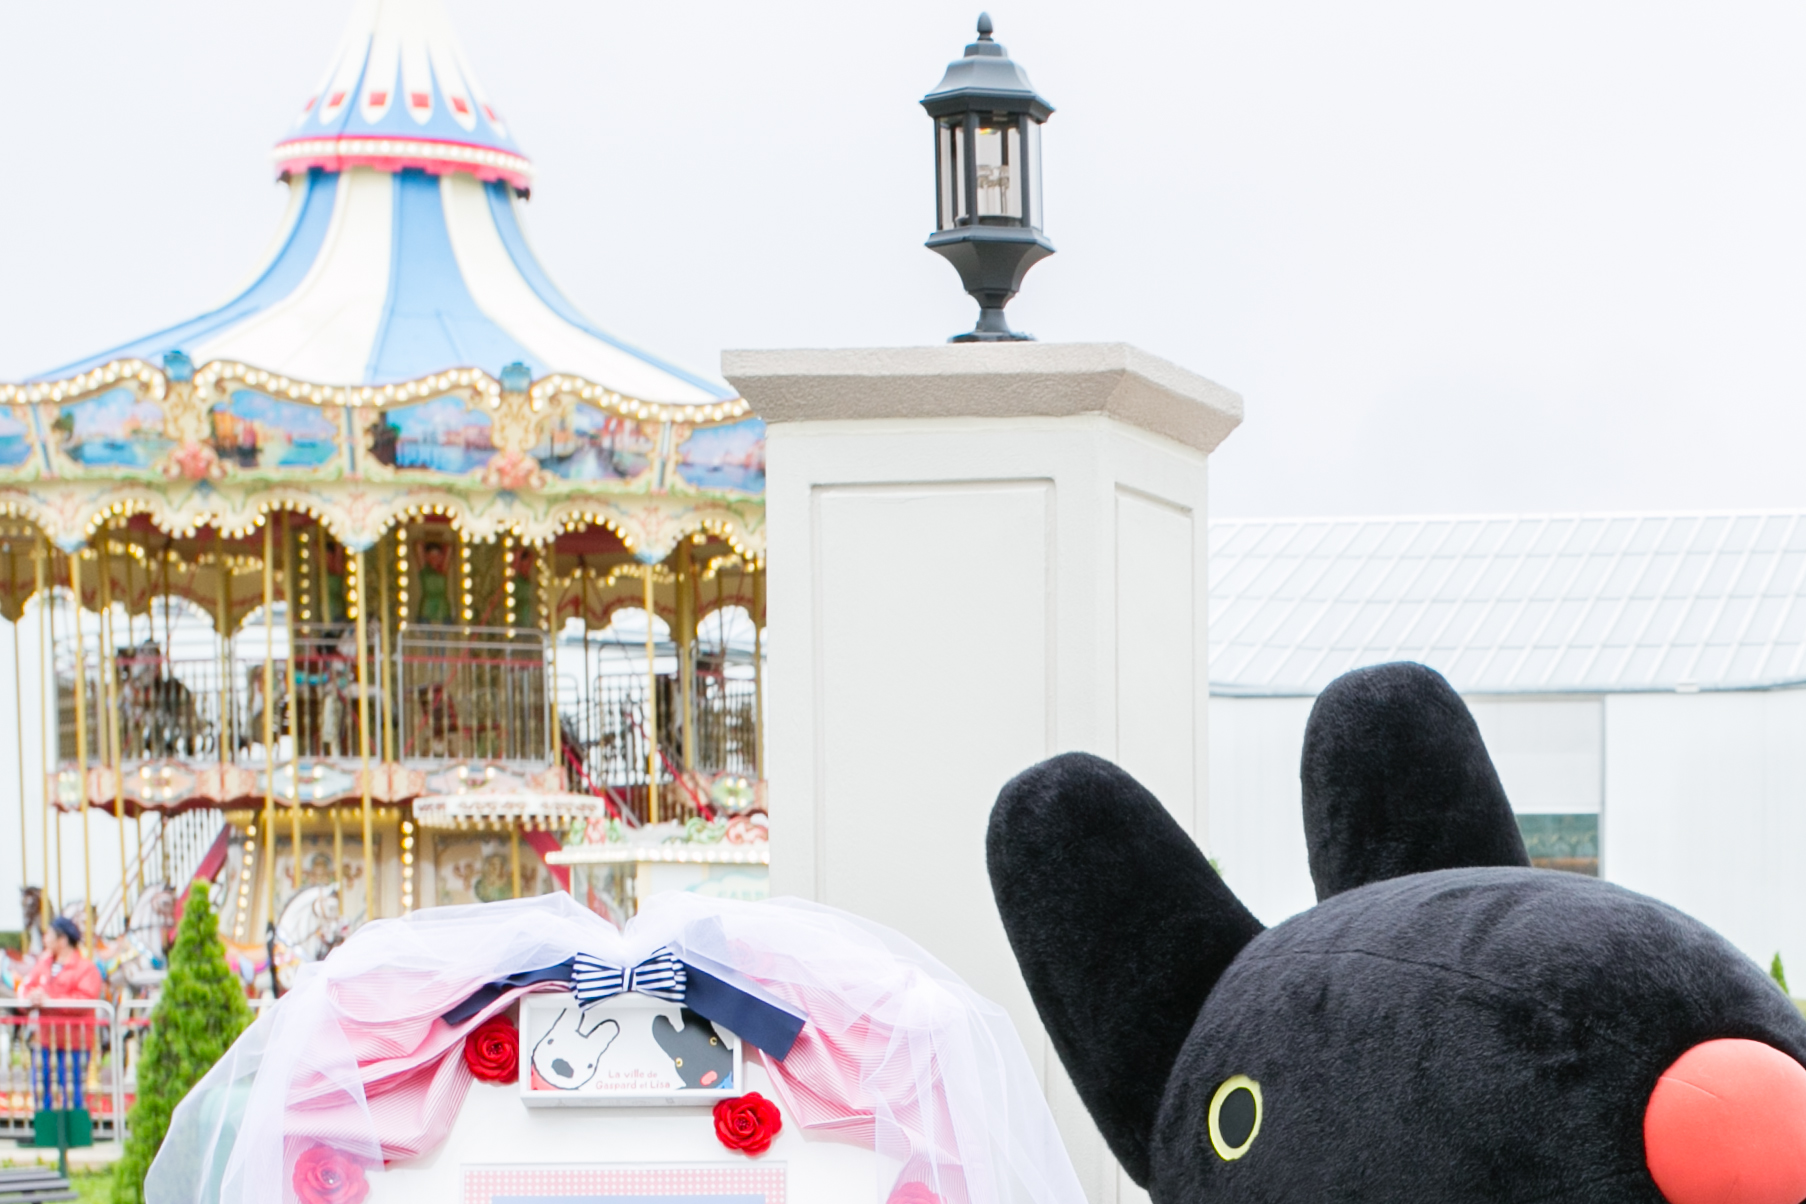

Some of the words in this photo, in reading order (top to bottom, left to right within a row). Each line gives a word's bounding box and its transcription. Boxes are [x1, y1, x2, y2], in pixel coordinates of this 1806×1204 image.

[608, 1070, 620, 1079] La
[624, 1068, 645, 1079] ville
[647, 1070, 658, 1078] de
[595, 1080, 637, 1091] Gaspard
[650, 1080, 671, 1089] Lisa
